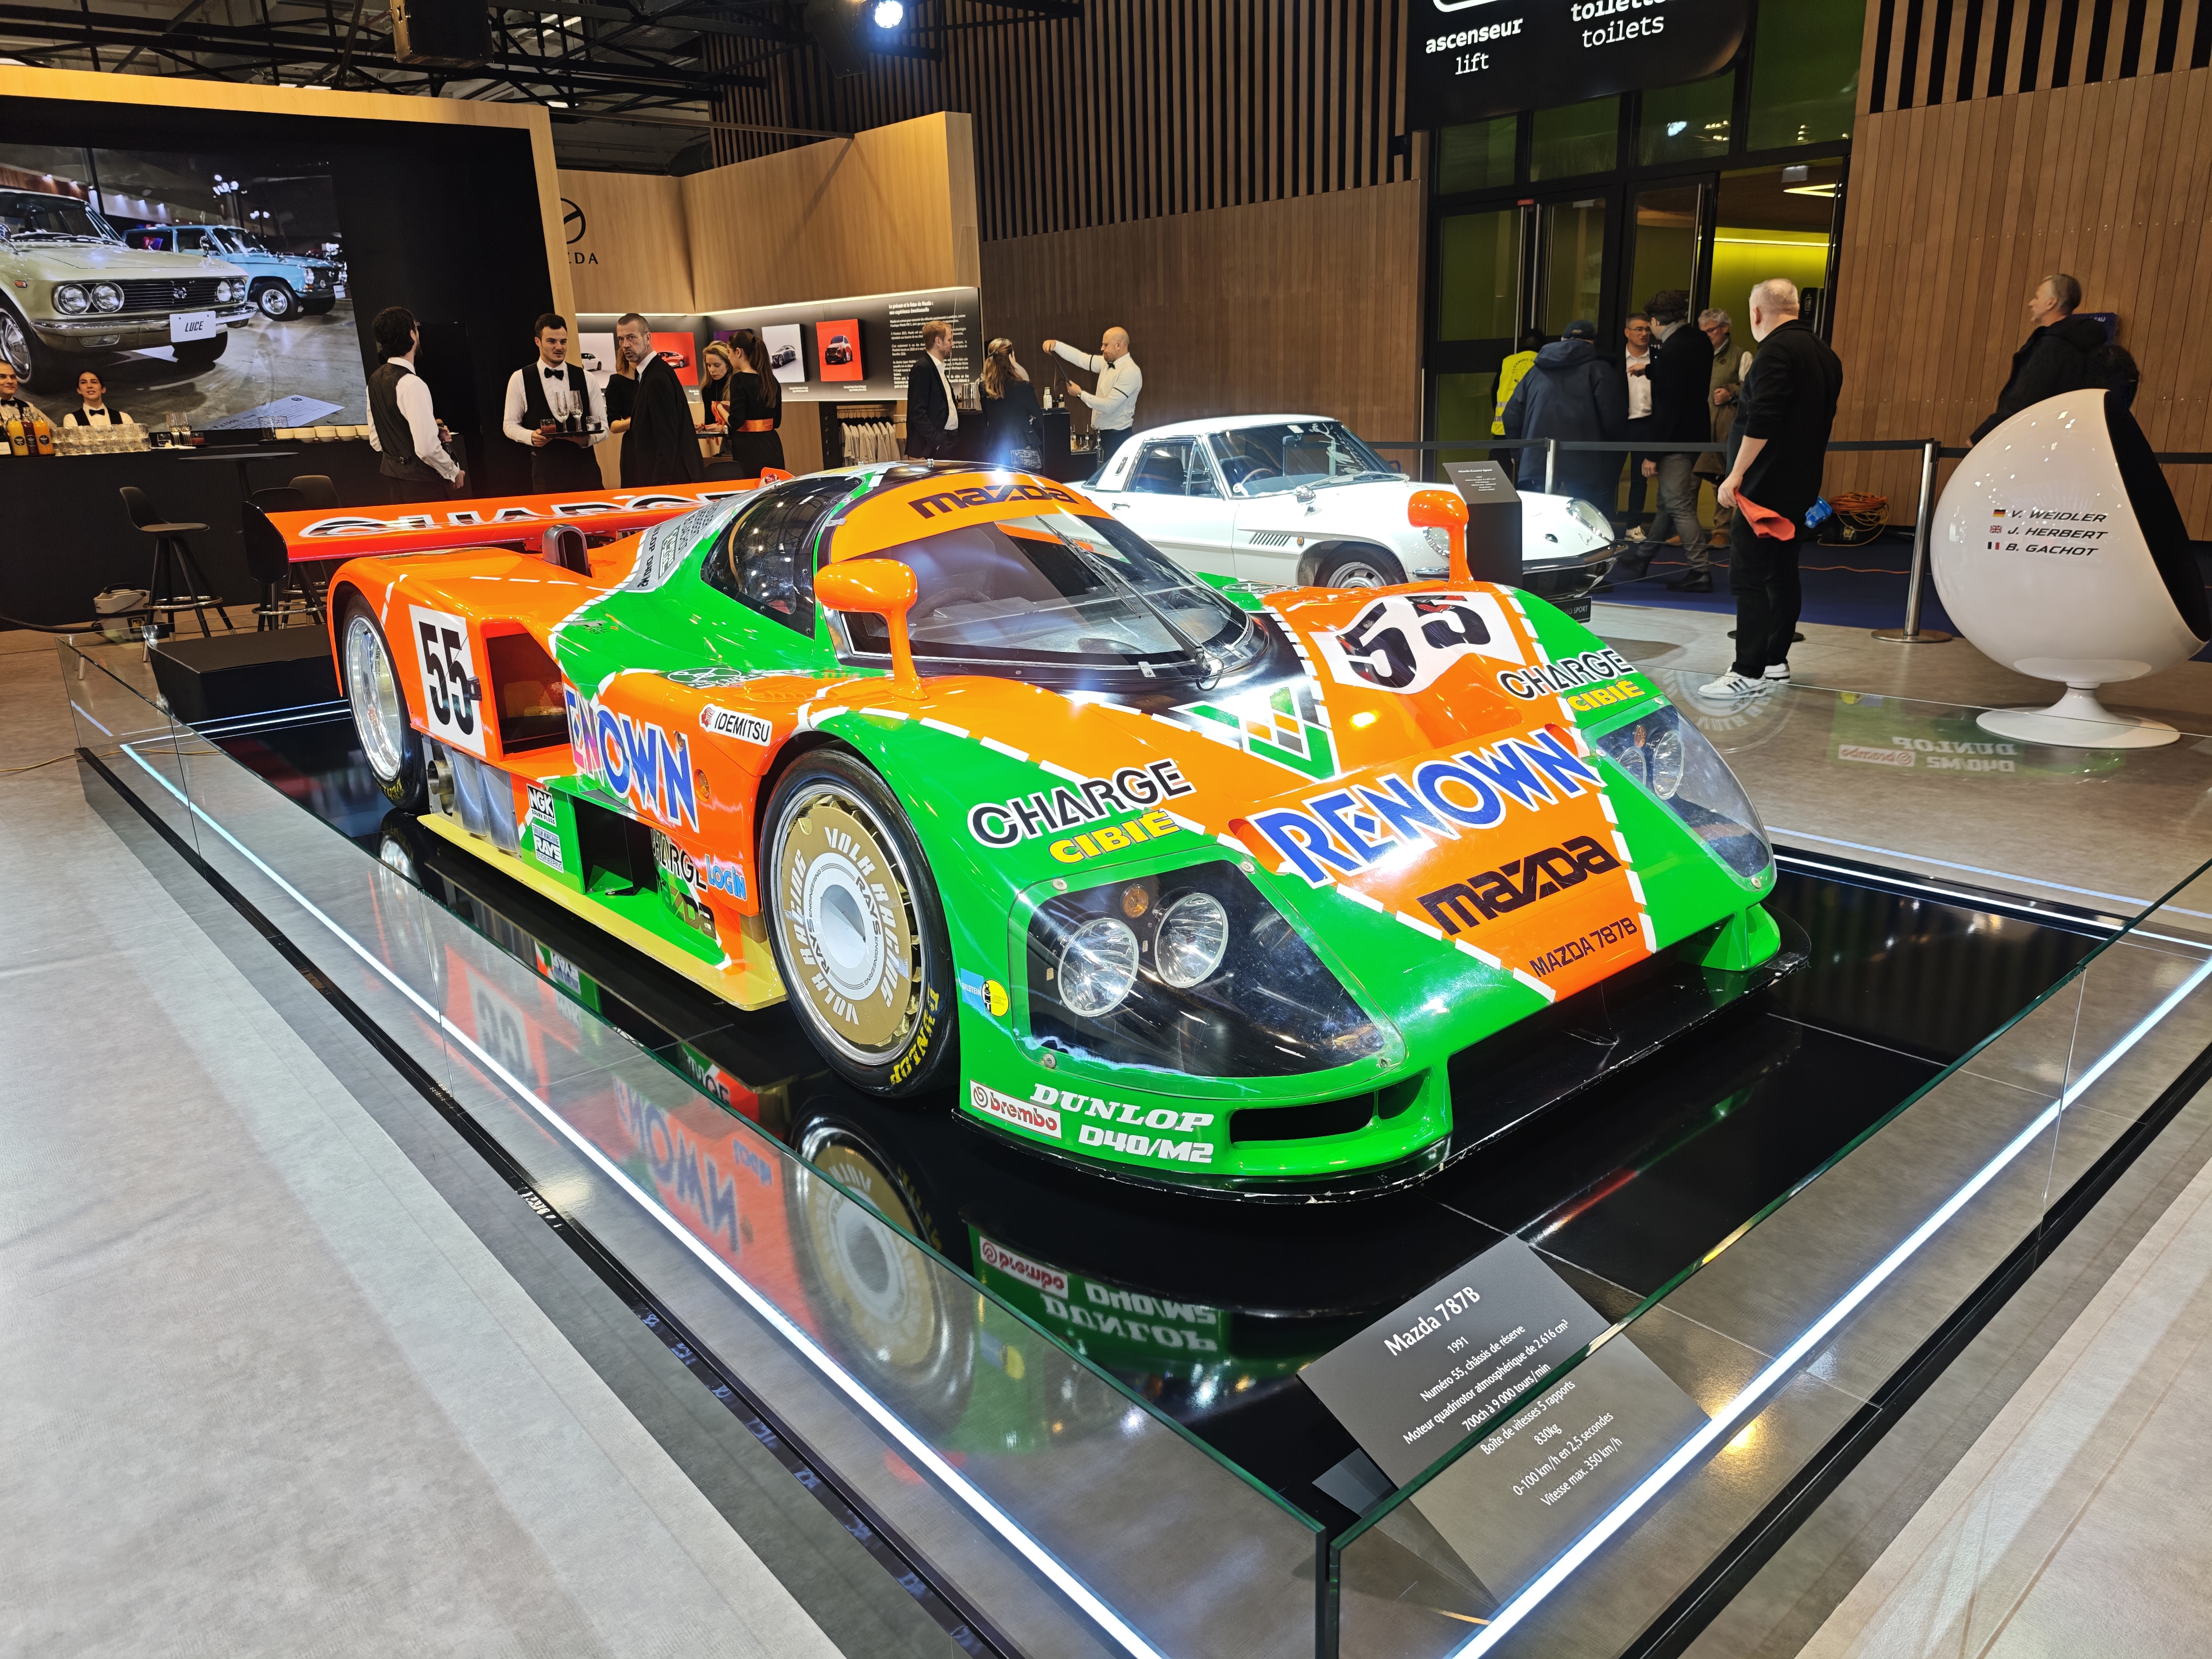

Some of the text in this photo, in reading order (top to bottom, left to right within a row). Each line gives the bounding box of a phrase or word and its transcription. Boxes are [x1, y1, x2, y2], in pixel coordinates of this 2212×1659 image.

[1571, 0, 1667, 22] toile
[1582, 16, 1664, 48] toilets
[1425, 18, 1523, 53] ascenseur
[1455, 52, 1489, 75] lift
[185, 320, 204, 333] LUCE
[2007, 527, 2109, 539] J. HERBERT
[2011, 510, 2108, 522] V. WEIDLER
[2005, 543, 2099, 556] B. GACHOT
[1573, 605, 1588, 614] SPORT
[1337, 595, 1491, 690] 55
[419, 621, 475, 736] 55
[1495, 648, 1638, 702] CHARGE
[713, 712, 771, 743] IDEMITSU
[564, 683, 700, 834] ENOWN
[528, 786, 555, 819] NGK
[531, 810, 555, 825] SPARK PLUGS
[967, 758, 1197, 849] CHARGE
[1246, 726, 1608, 889] RENOWN
[536, 840, 561, 862] RAYS
[536, 852, 563, 869] ENGINEERING
[807, 868, 830, 975] RAYS ENGINEERING
[824, 826, 900, 1008] VOLK RACING
[855, 876, 881, 986] RAYS ENGINEERING
[1529, 916, 1637, 979] MAZDA 787B
[811, 972, 859, 1026] VOLK
[961, 982, 982, 996] BILSTEIN
[990, 1091, 1058, 1131] brembo
[1029, 1083, 1215, 1133] DUNLOP
[1077, 1123, 1215, 1164] D40/M2
[1384, 1286, 1480, 1356] Mazda 787B
[1419, 1326, 1526, 1402] Numéro 55, châssis de réserve
[1447, 1336, 1469, 1353] 1991
[1402, 1419, 1435, 1445] Moteur
[1433, 1389, 1476, 1424] quadrirotor
[1474, 1352, 1527, 1393] atmosphérique
[1525, 1345, 1537, 1355] de
[1461, 1409, 1490, 1431] 700ch
[1485, 1404, 1496, 1413] à
[1513, 1364, 1551, 1393] tours/min
[1480, 1381, 1575, 1455] Boîte de vitesses 5 rapports
[1534, 1424, 1562, 1445] 830kg
[1513, 1412, 1614, 1495] 0-100 km/h en 2,5 secondes
[1540, 1437, 1623, 1506] Vitesse max. 350 km/h
